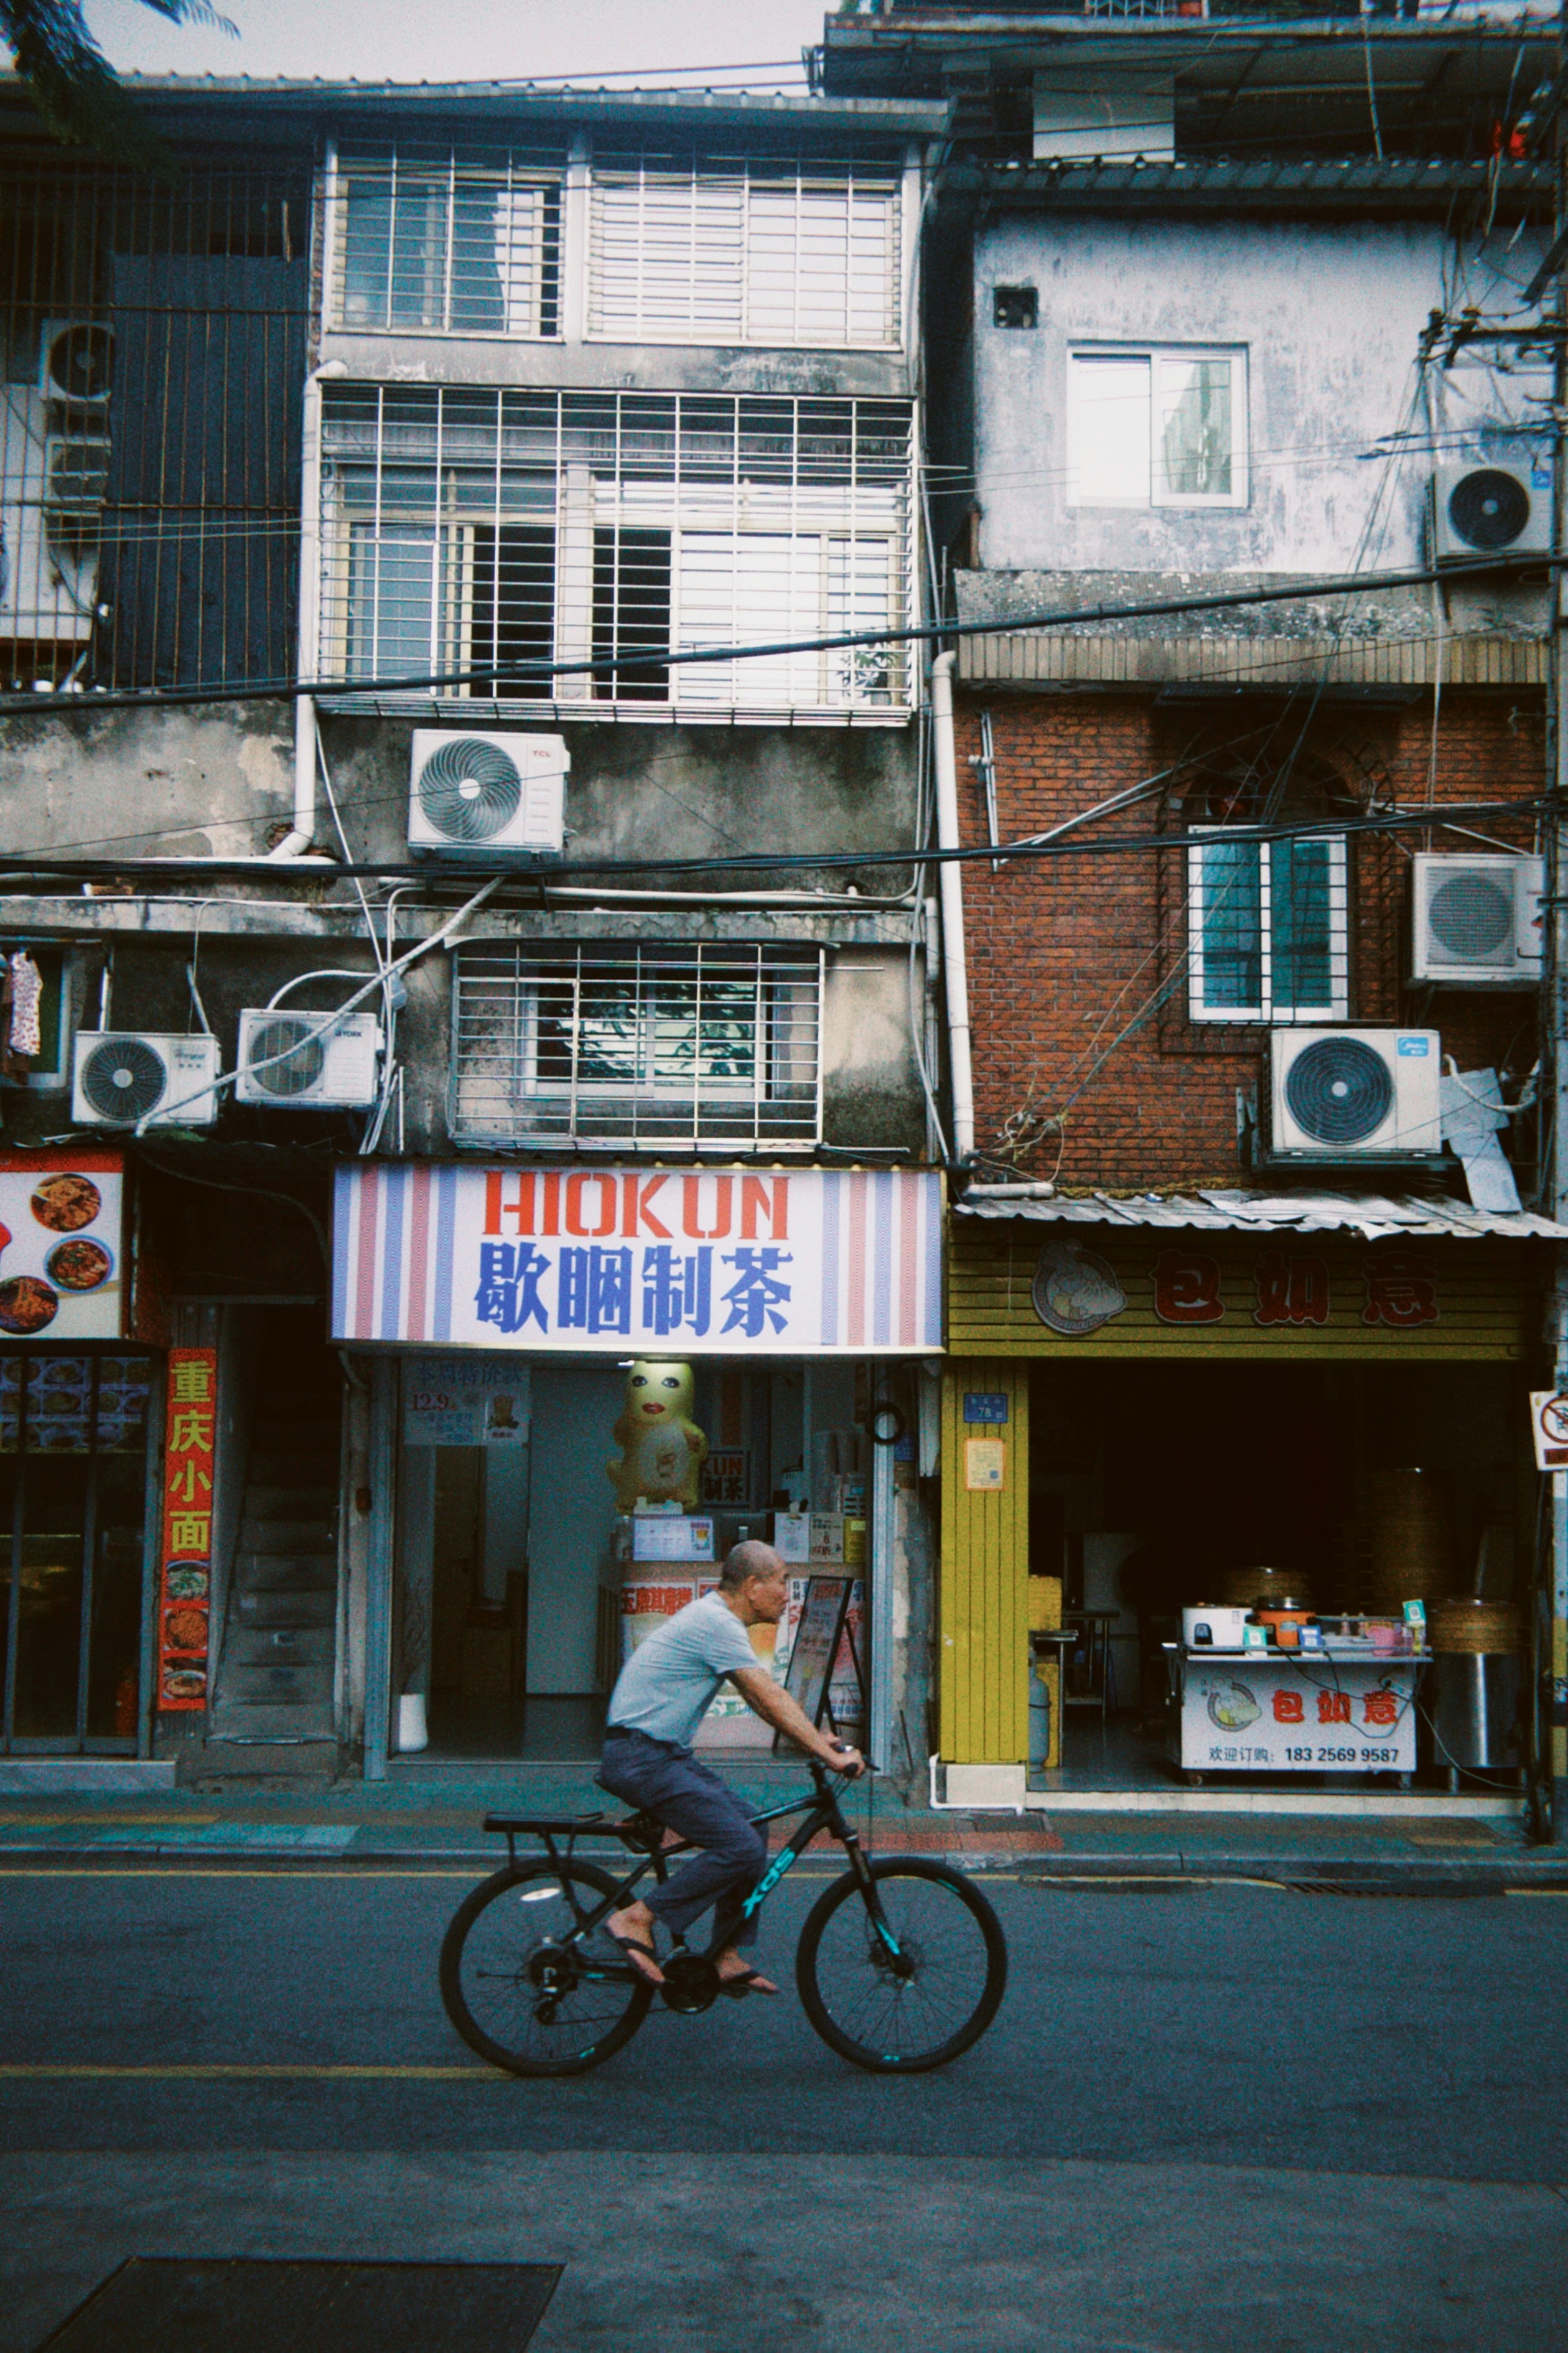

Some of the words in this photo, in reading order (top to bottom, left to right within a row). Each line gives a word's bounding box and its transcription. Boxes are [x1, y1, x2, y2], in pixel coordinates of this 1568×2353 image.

[481, 1170, 790, 1240] HIOKUN
[474, 1242, 795, 1337] 歇睏制茶
[1149, 1248, 1441, 1327] 包如意
[169, 1360, 214, 1554] 重庆小面
[1272, 1688, 1400, 1725] 包如意
[1285, 1747, 1312, 1761] 183
[1317, 1747, 1356, 1762] 2569
[1360, 1747, 1399, 1763] 9587
